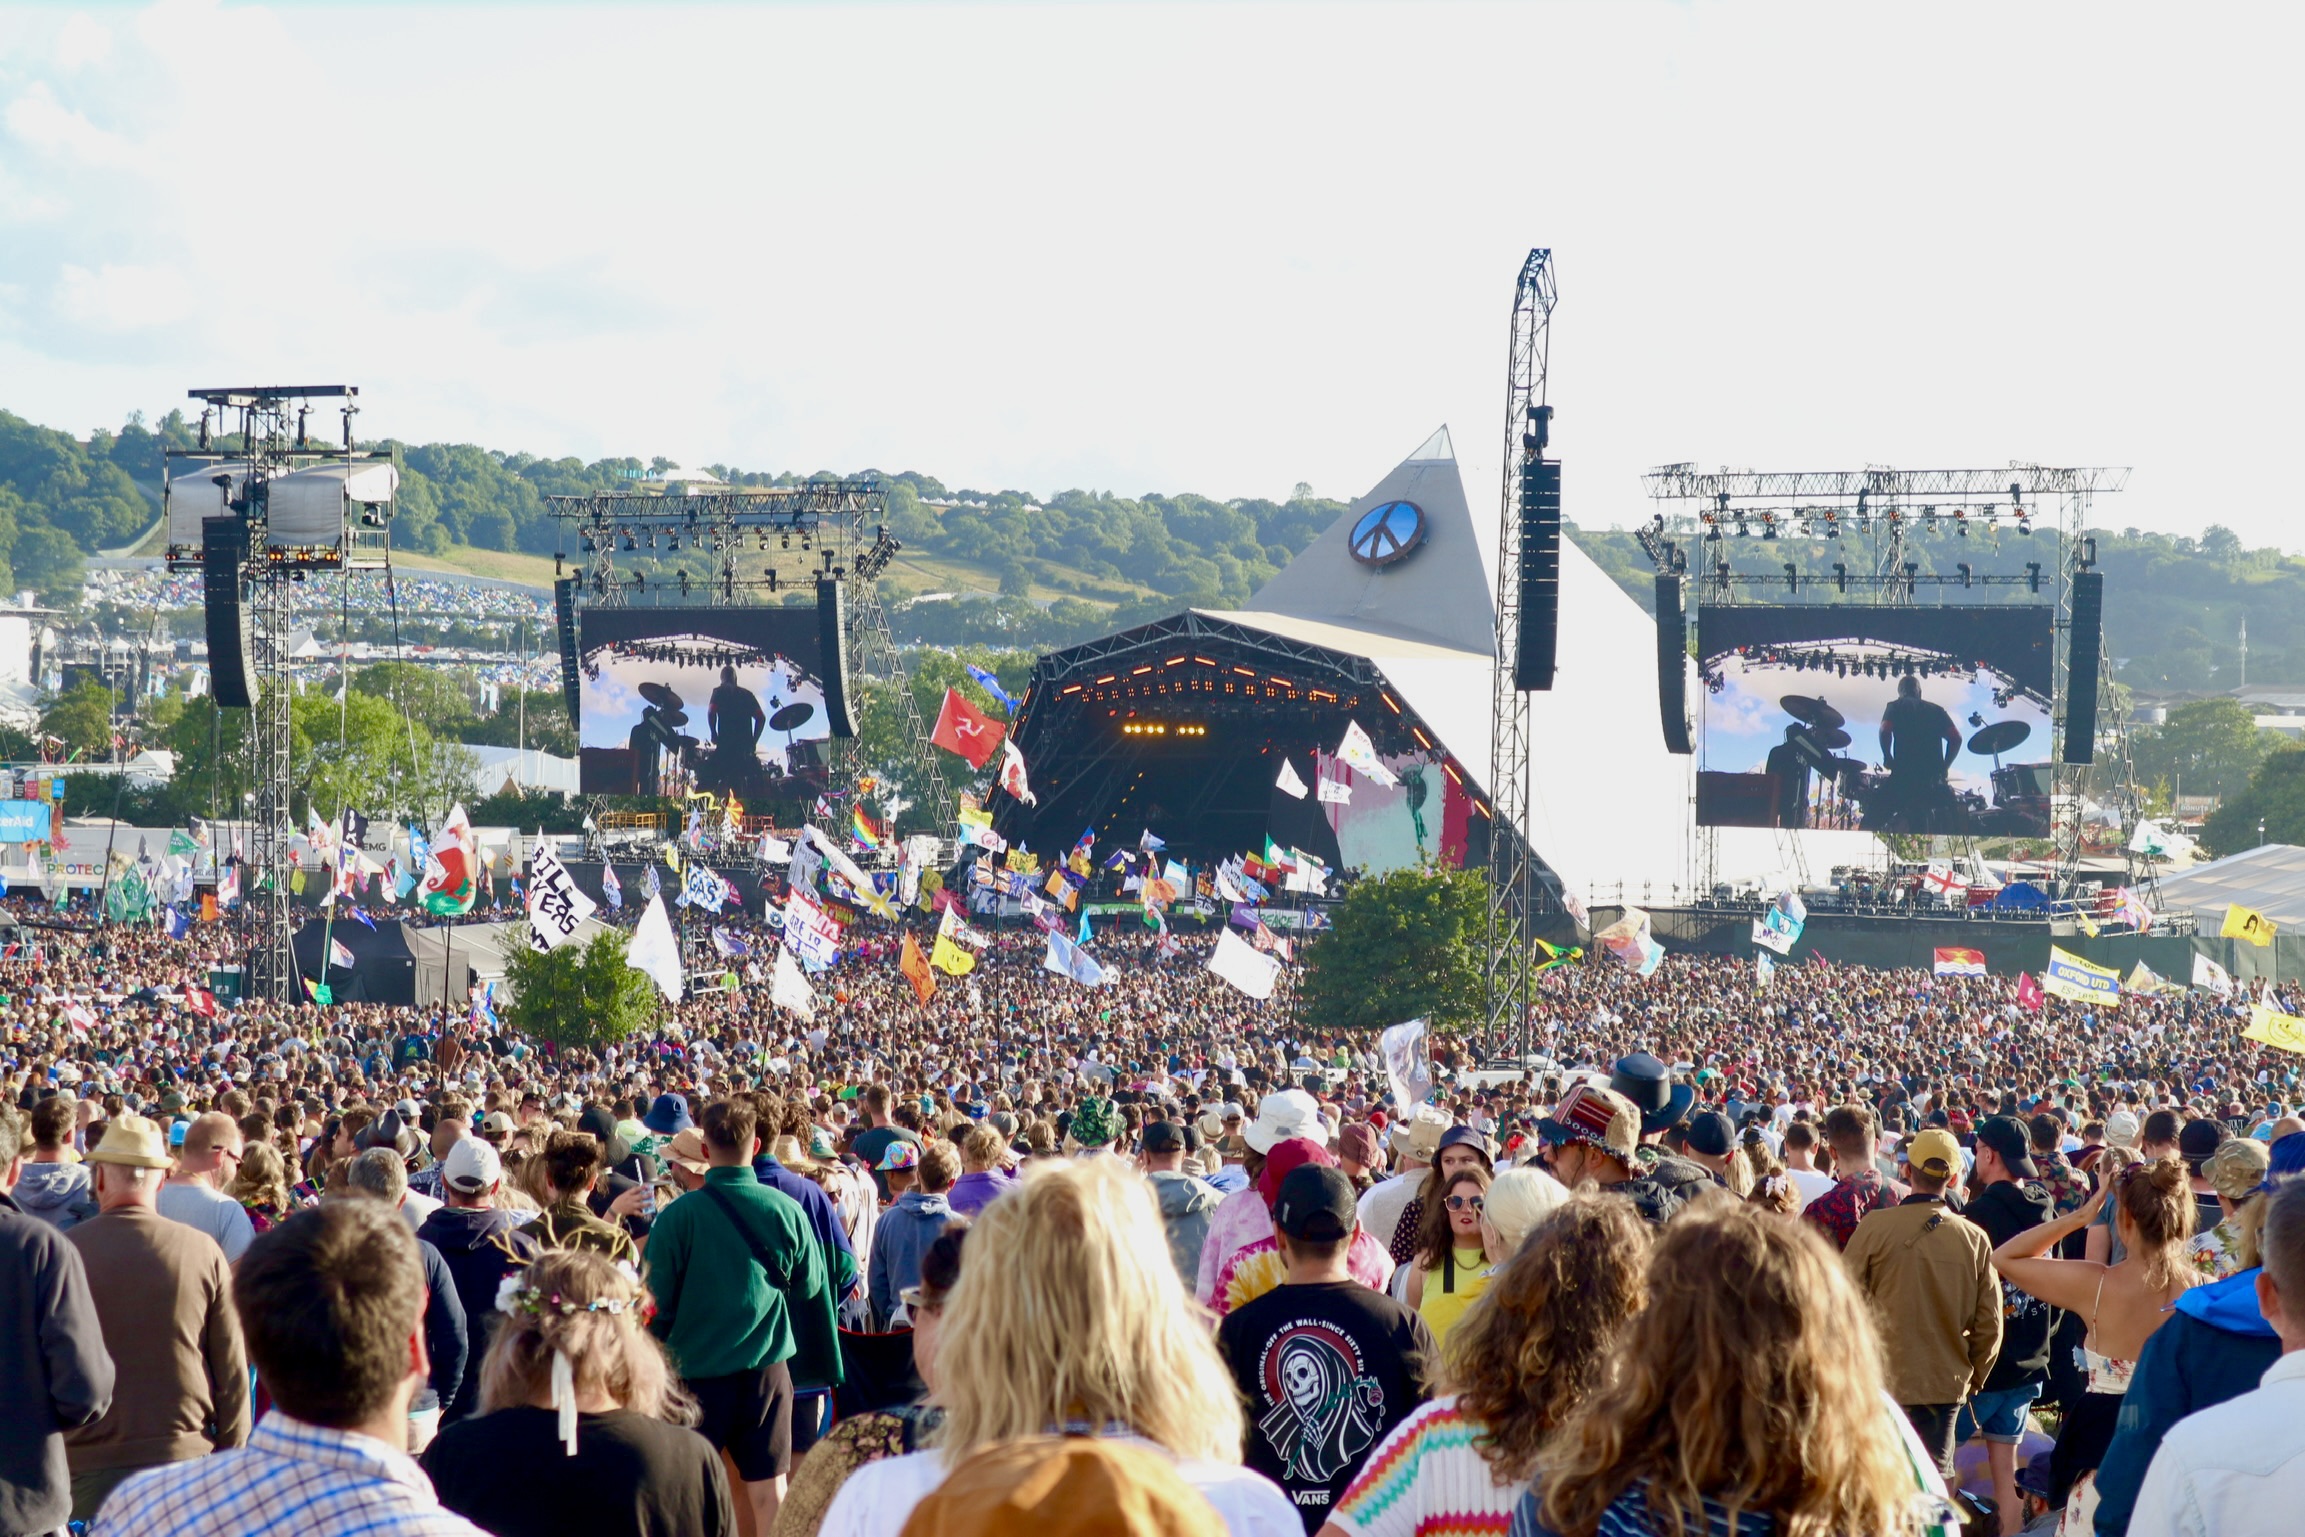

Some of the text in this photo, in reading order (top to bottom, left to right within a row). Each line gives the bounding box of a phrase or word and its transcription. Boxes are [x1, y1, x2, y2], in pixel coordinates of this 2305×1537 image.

[2091, 977, 2110, 991] UTD
[1258, 1318, 1365, 1407] THE ORIGINAL OFF THE WALL SINCE SIXTY SIX
[1291, 1489, 1331, 1506] VANS
